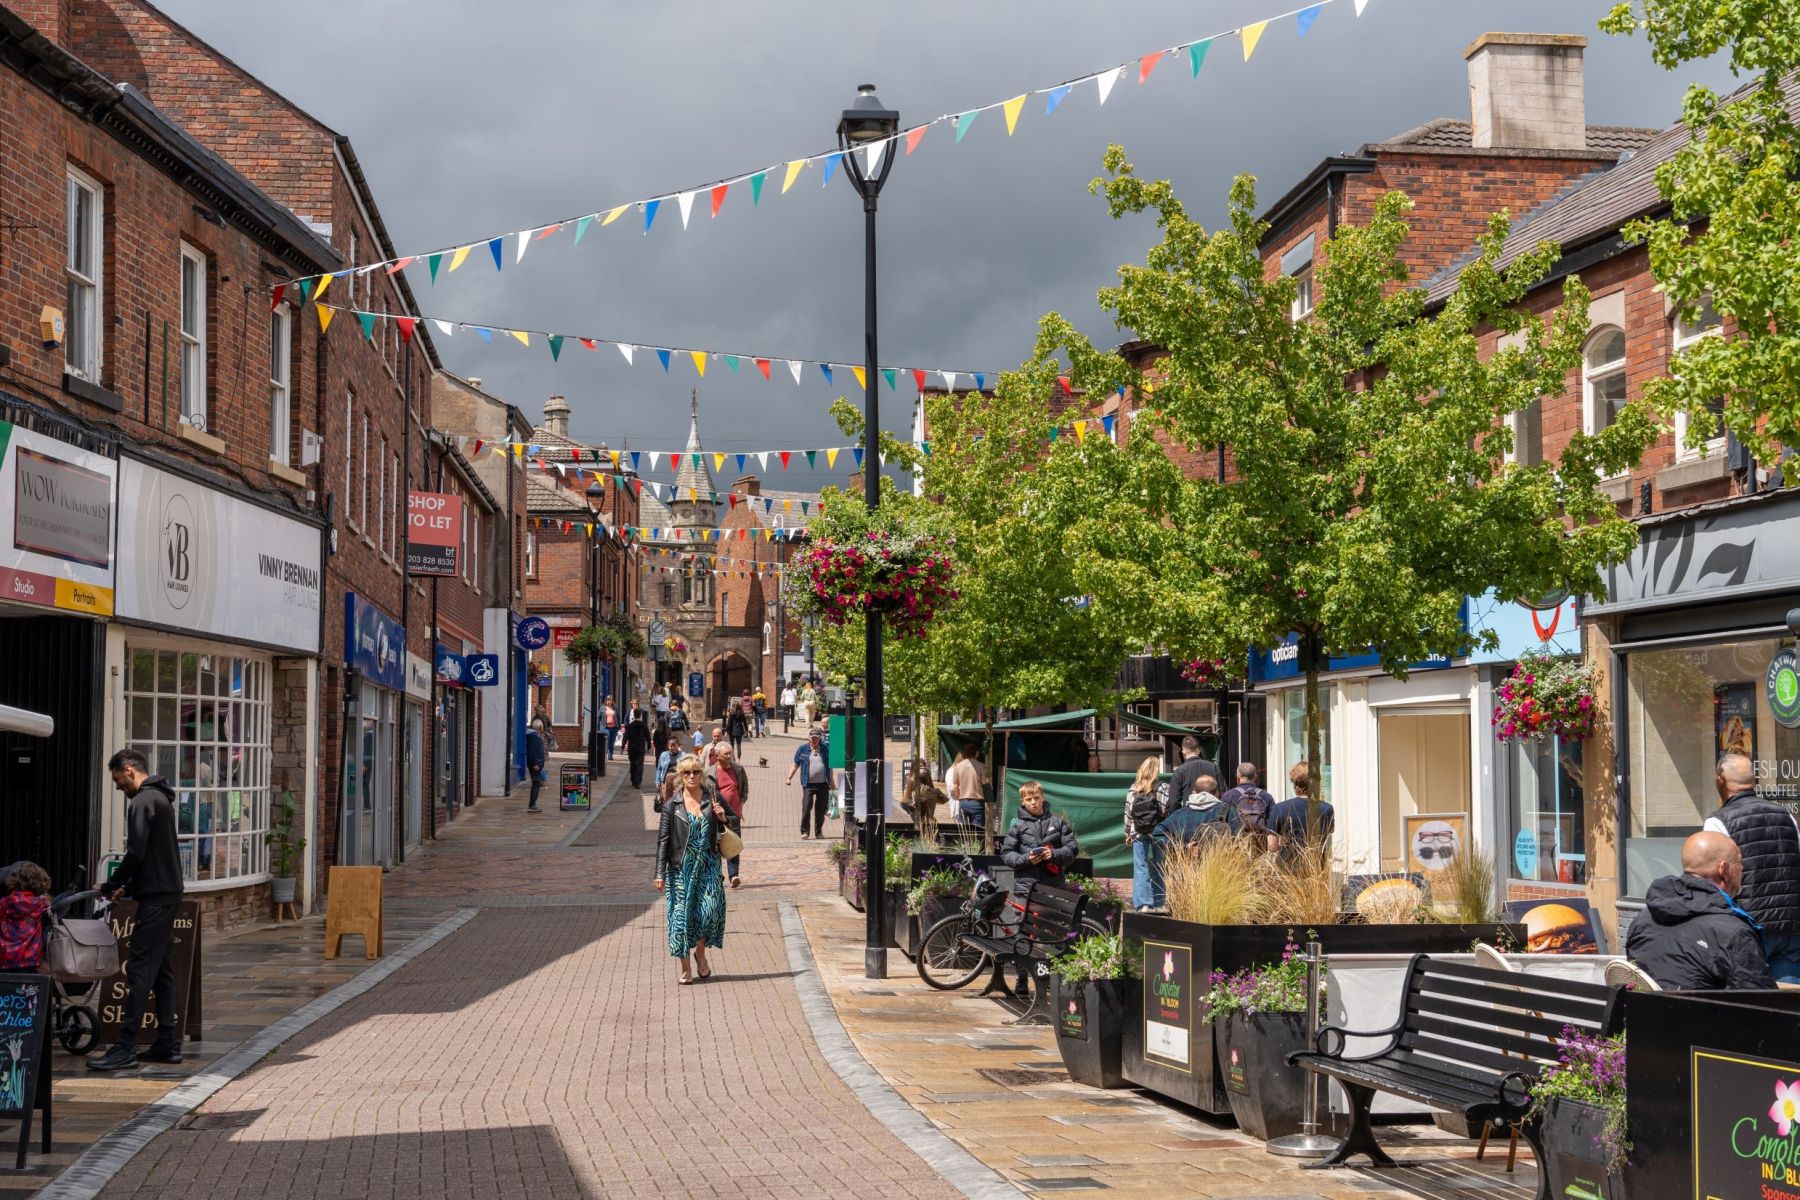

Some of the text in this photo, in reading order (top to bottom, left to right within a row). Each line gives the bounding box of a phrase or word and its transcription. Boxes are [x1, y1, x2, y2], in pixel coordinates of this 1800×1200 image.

[21, 470, 58, 504] WOW
[408, 495, 446, 511] SHOP
[408, 513, 452, 529] TO LET
[422, 556, 436, 565] 828
[437, 557, 455, 567] 8530
[258, 553, 318, 590] VINNY BRENNAN
[14, 576, 35, 596] Studio
[73, 588, 96, 606] Portraits
[1753, 759, 1778, 779] ESH
[1765, 783, 1798, 798] COFFEE
[0, 1011, 33, 1028] Chloe
[1761, 1162, 1800, 1187] IN BL
